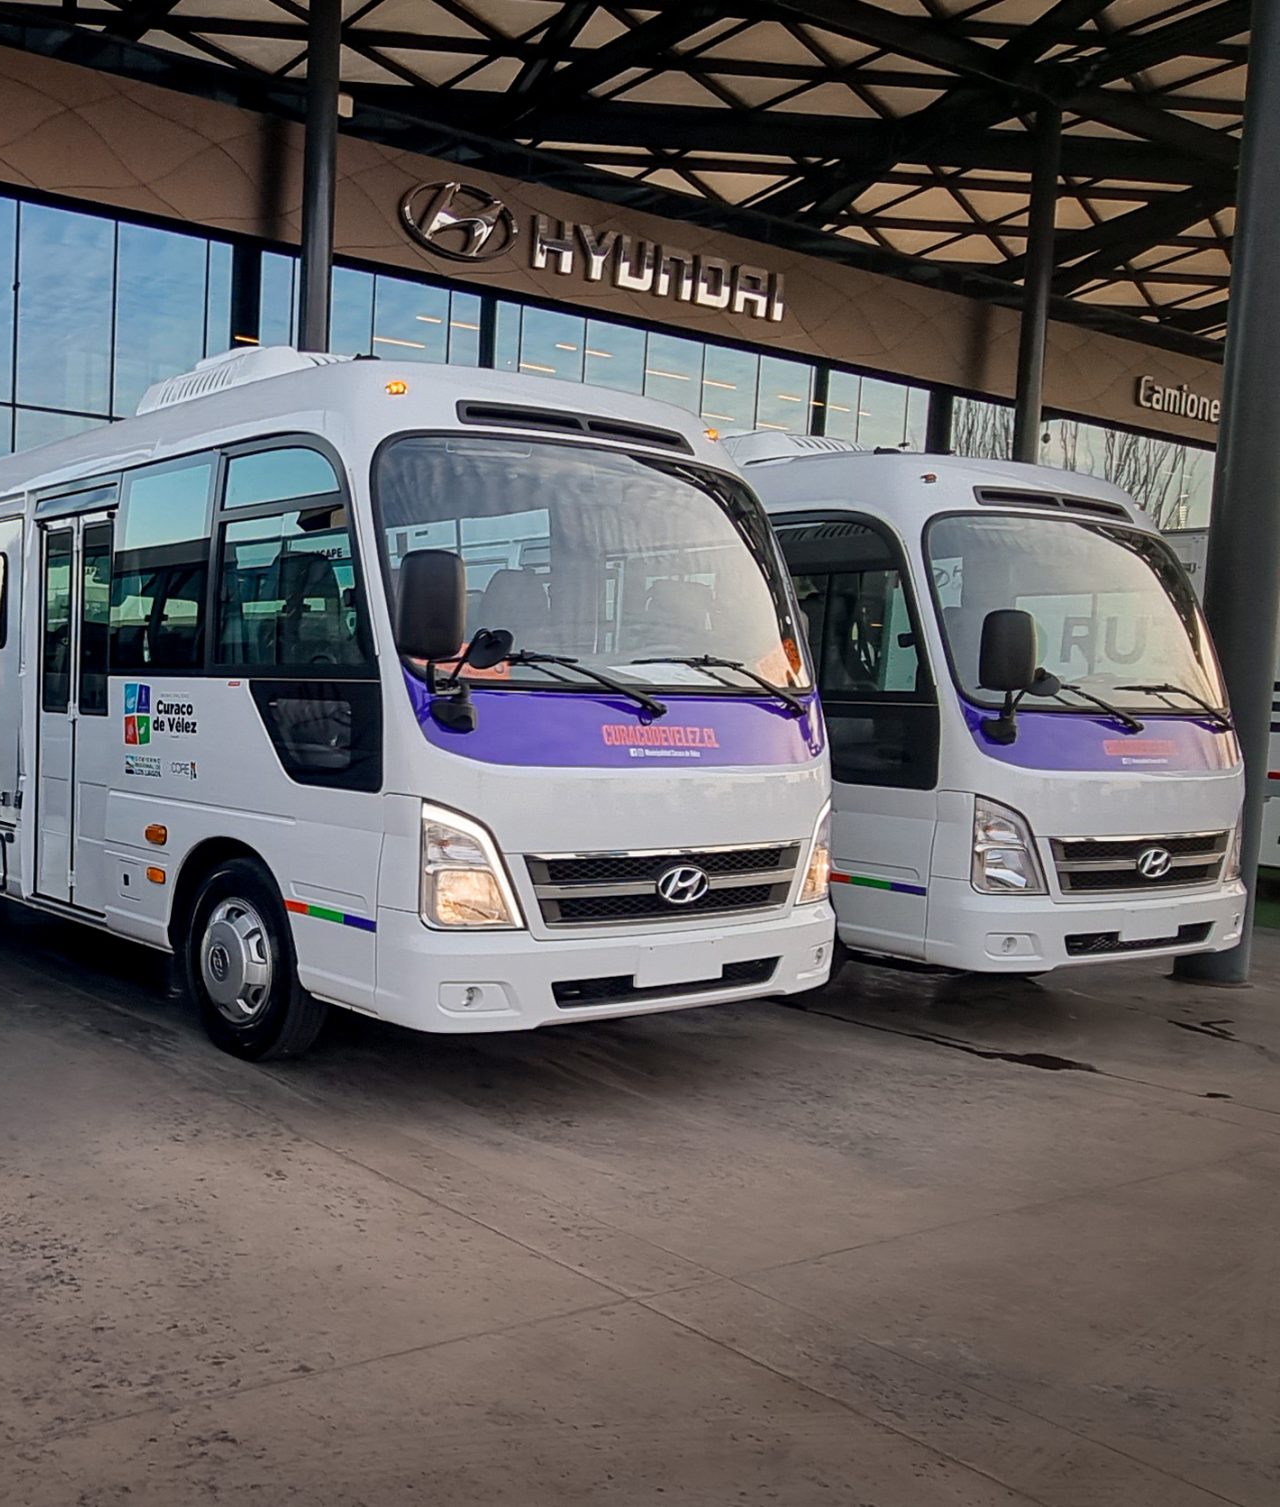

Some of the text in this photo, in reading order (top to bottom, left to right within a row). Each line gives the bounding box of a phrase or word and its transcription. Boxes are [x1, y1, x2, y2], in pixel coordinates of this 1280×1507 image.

[531, 213, 784, 323] HYUNDAI
[1137, 375, 1220, 423] Camione
[156, 699, 194, 716] Curaco
[153, 716, 197, 734] de Vélez
